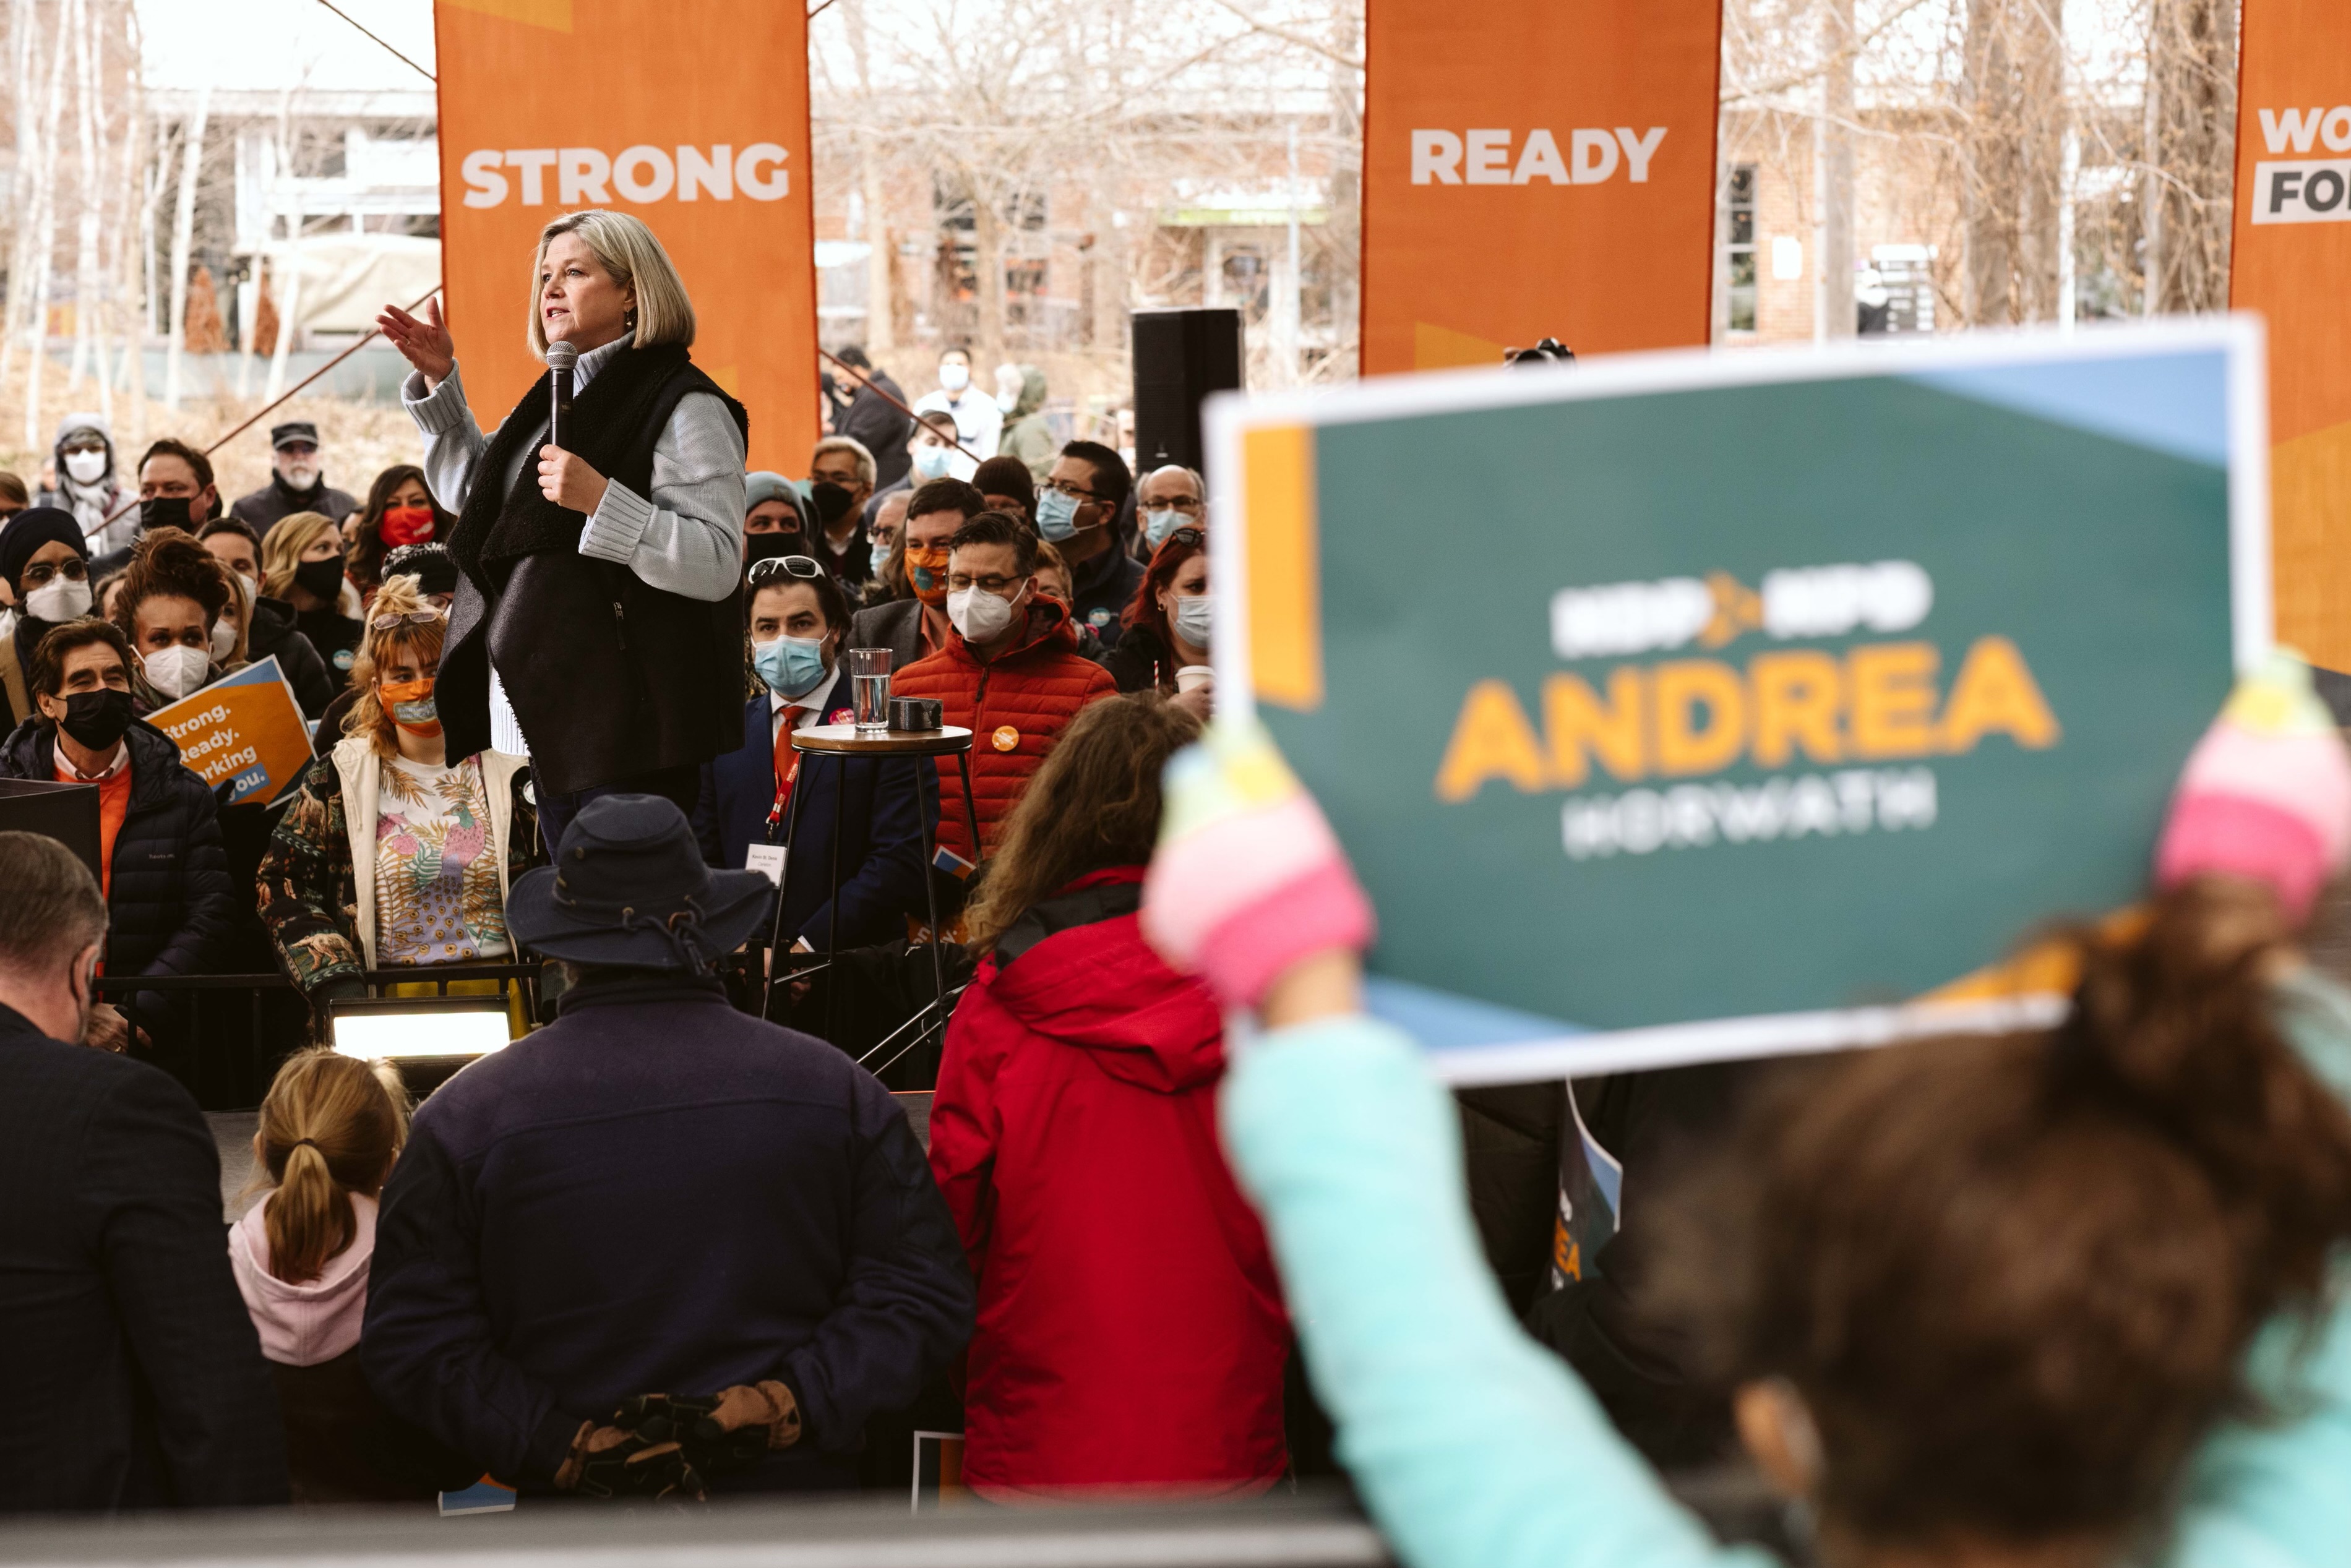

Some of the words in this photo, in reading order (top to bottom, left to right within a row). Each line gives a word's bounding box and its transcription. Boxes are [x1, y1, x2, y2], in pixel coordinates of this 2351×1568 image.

[462, 142, 789, 209] STRONG
[1411, 127, 1668, 186] READY
[2269, 169, 2351, 213] FO
[179, 728, 239, 765] Ready.
[1434, 633, 2063, 804] ANDREA
[1561, 767, 1937, 860] HORWATH
